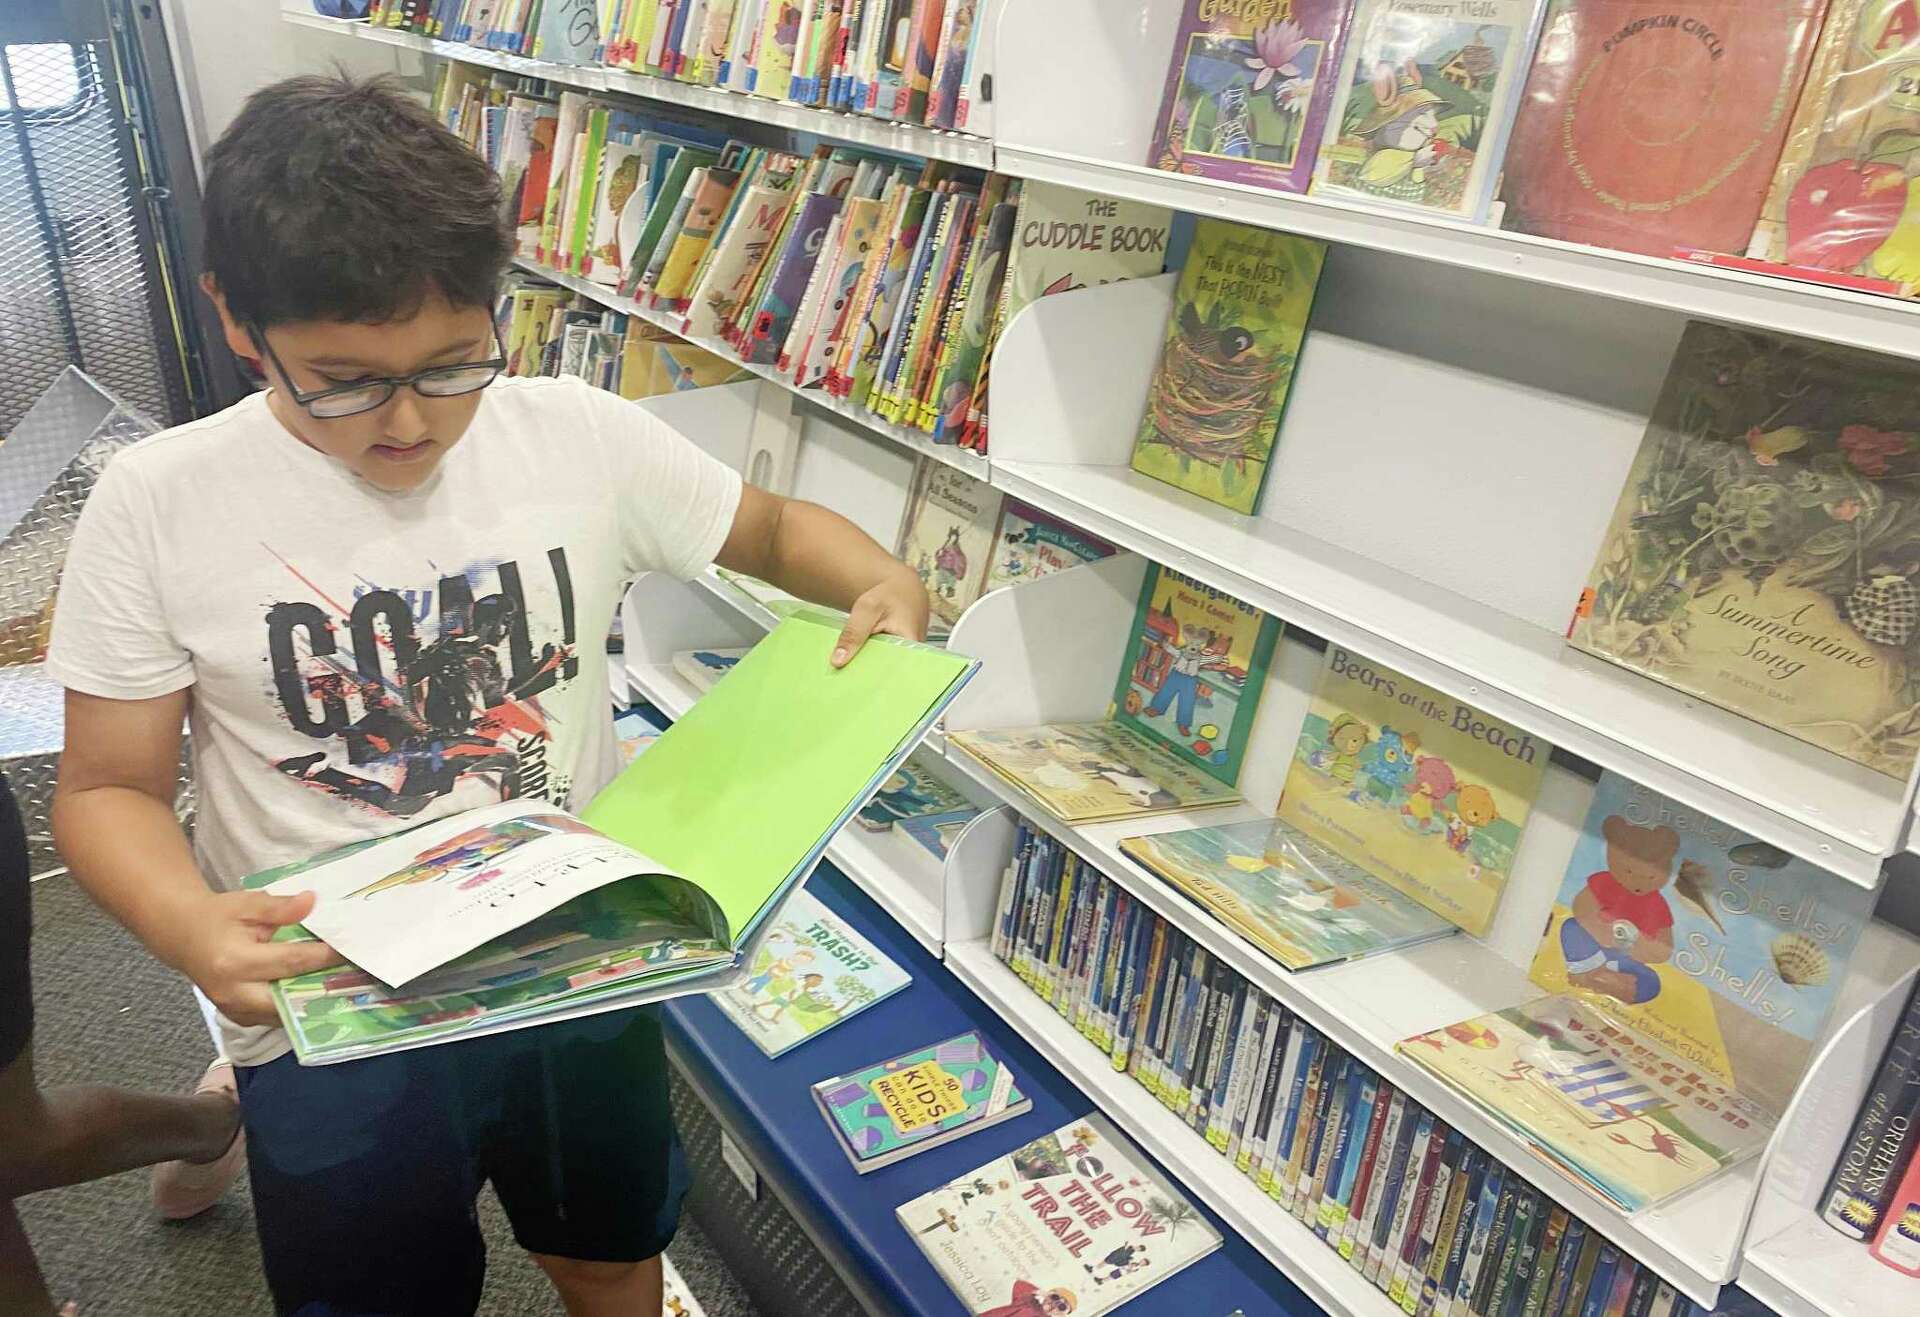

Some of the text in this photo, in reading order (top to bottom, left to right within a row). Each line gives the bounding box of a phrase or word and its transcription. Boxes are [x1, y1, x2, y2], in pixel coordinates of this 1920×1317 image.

[1602, 15, 1724, 61] PUMPKIN CIRCLE
[1085, 199, 1118, 217] THE
[1022, 221, 1167, 253] CUDDLE BOOK
[1704, 594, 1878, 669] Summertime
[1771, 603, 1815, 627] A
[1734, 635, 1806, 679] Song
[1329, 649, 1536, 765] Bears at the Beach
[1719, 868, 1847, 944] Shells!
[805, 922, 871, 972] TRASH?
[1675, 933, 1794, 1026] Shells!
[878, 1080, 916, 1128] RECYCLE
[904, 1070, 947, 1118] KIDS
[943, 1078, 959, 1091] 50
[1837, 1135, 1874, 1194] STORM
[1861, 1114, 1909, 1197] ORPHANS
[1059, 1179, 1113, 1230] THE
[1065, 1143, 1166, 1237] FOLLOW
[1021, 1182, 1093, 1259] TRAIL
[940, 1240, 992, 1303] Jessica Loy
